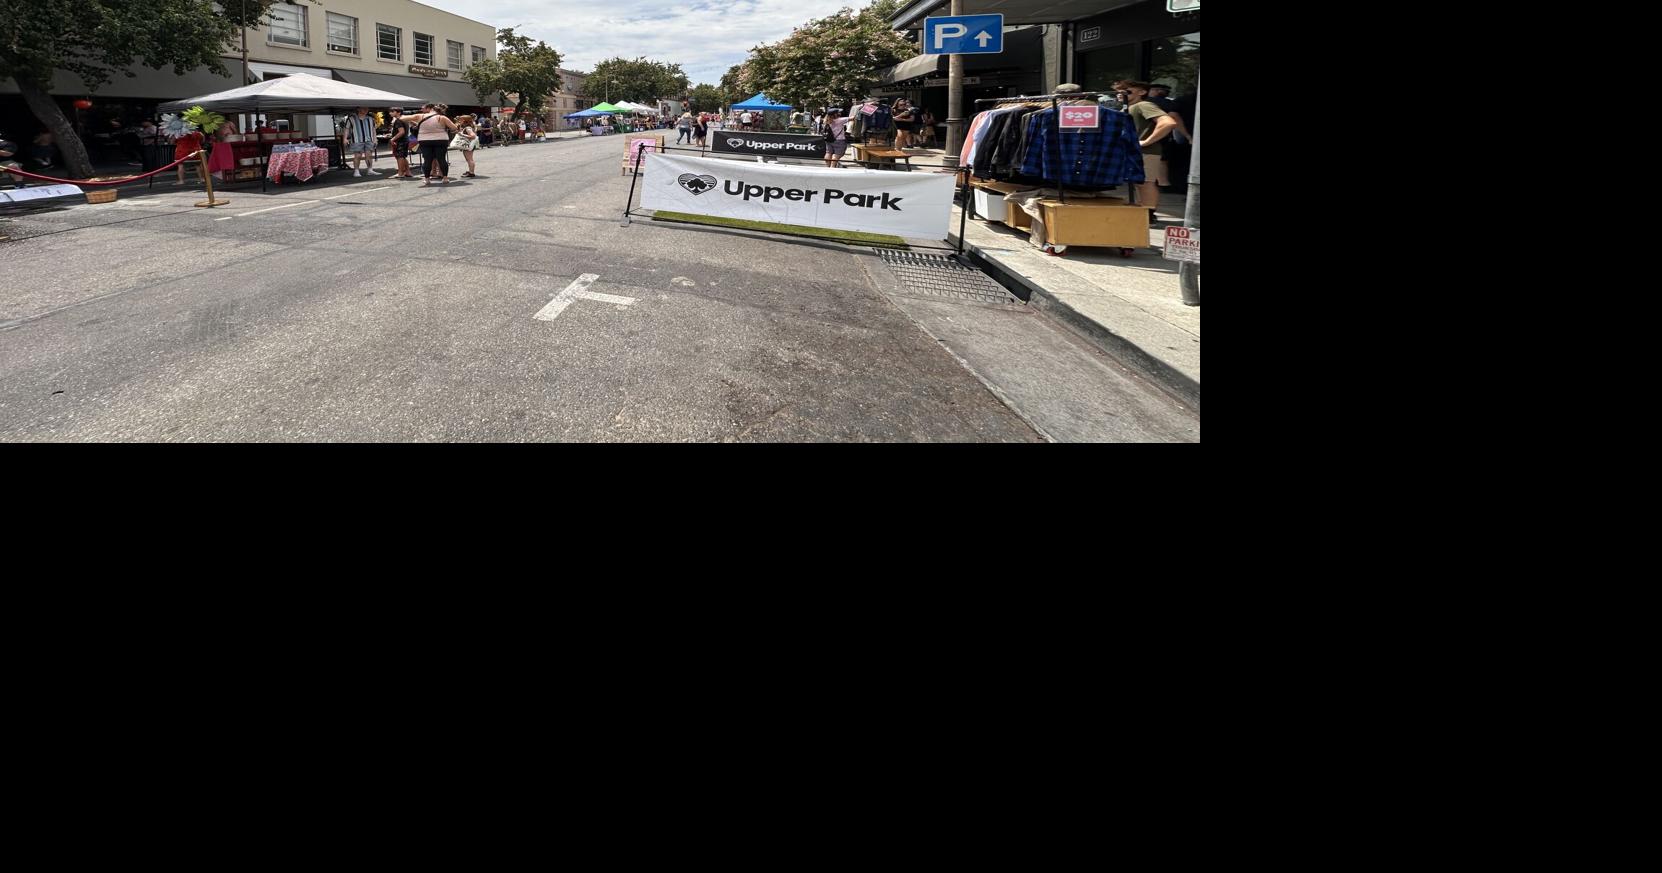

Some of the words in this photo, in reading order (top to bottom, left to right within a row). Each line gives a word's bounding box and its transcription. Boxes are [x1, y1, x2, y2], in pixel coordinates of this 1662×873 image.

[934, 23, 968, 49] P
[1083, 29, 1098, 40] 122
[1065, 111, 1093, 119] $20
[746, 140, 784, 150] Upper
[786, 142, 816, 151] Park
[724, 180, 818, 202] Upper
[823, 188, 904, 211] Park
[1169, 228, 1187, 238] NO
